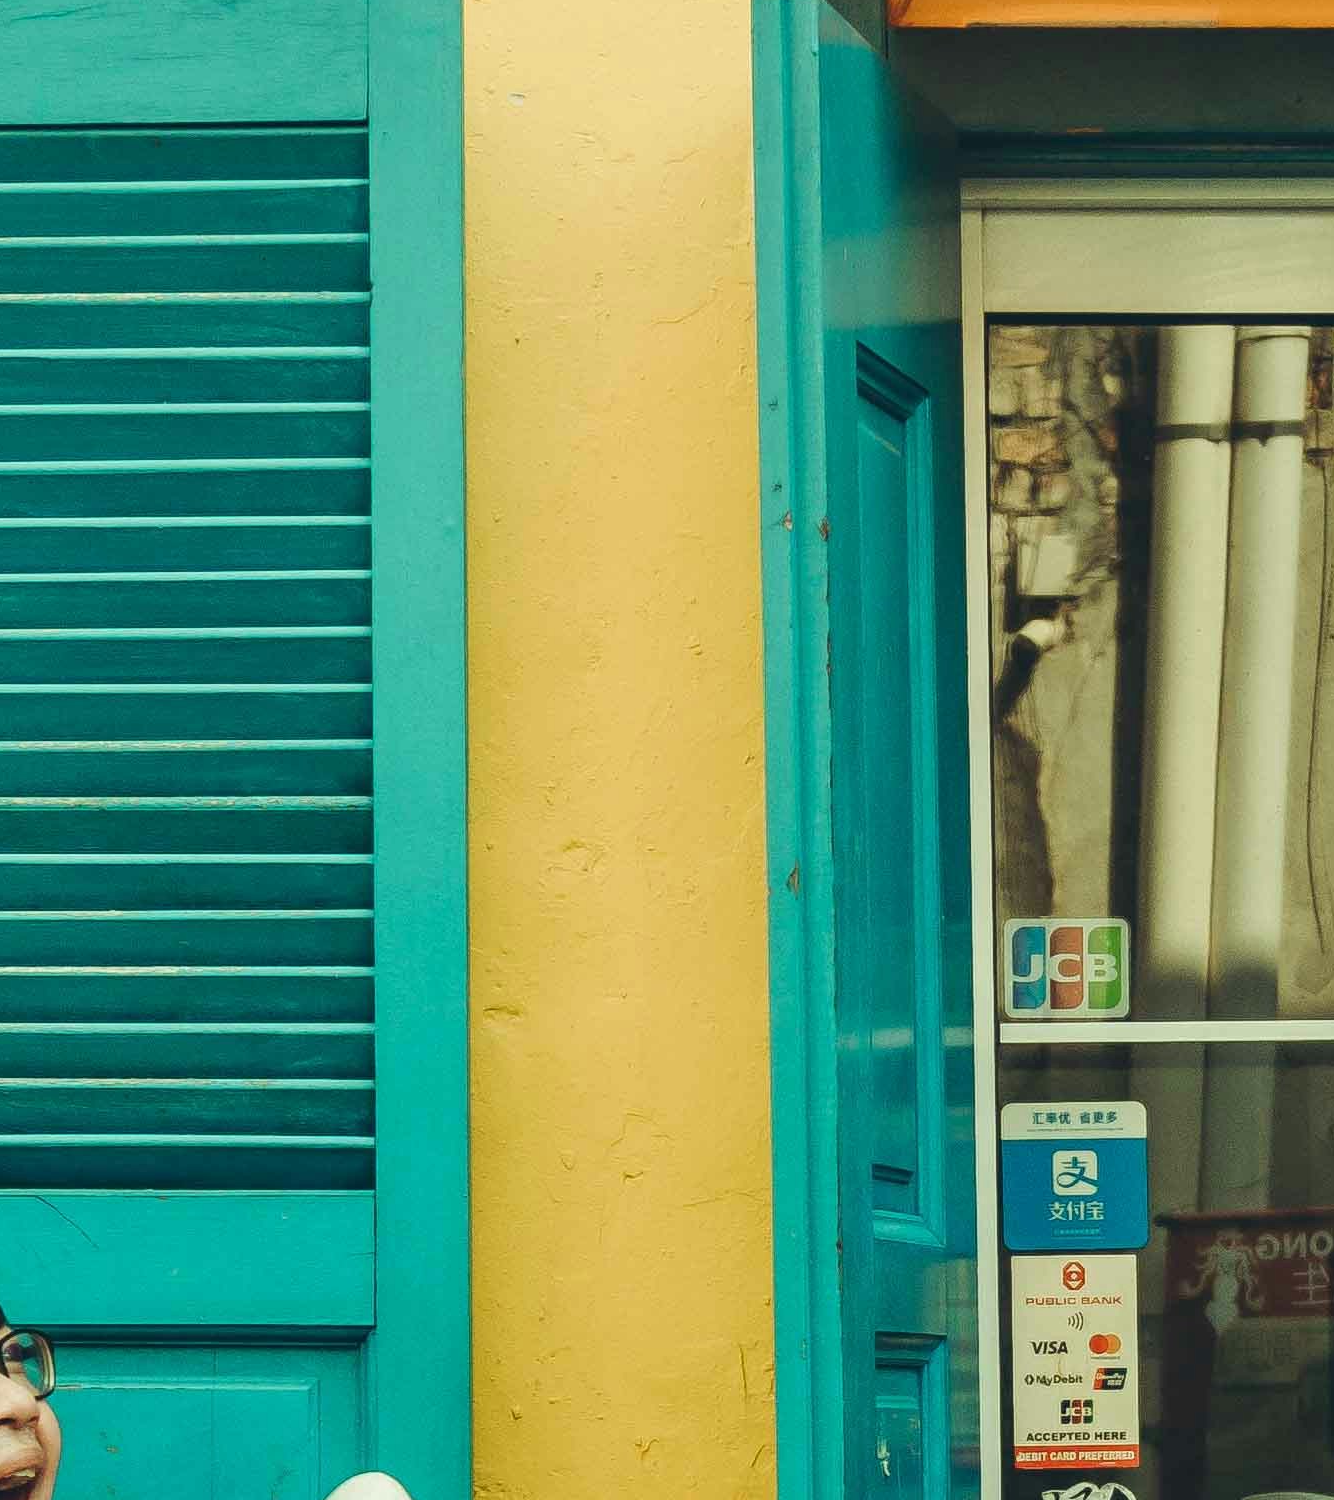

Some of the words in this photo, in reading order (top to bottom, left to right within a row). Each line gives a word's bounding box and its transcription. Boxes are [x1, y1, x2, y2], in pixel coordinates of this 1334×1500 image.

[1048, 1200, 1104, 1221] 支付宝
[1025, 1296, 1076, 1306] PUBLIC
[1081, 1295, 1123, 1305] BANK
[1030, 1340, 1069, 1355] VISA
[1026, 1431, 1091, 1442] ACCEPTED
[1094, 1430, 1127, 1441] HERE
[1017, 1451, 1047, 1462] DEBIT
[1050, 1451, 1077, 1461] CARD
[1078, 1450, 1135, 1461] PREFERRED
